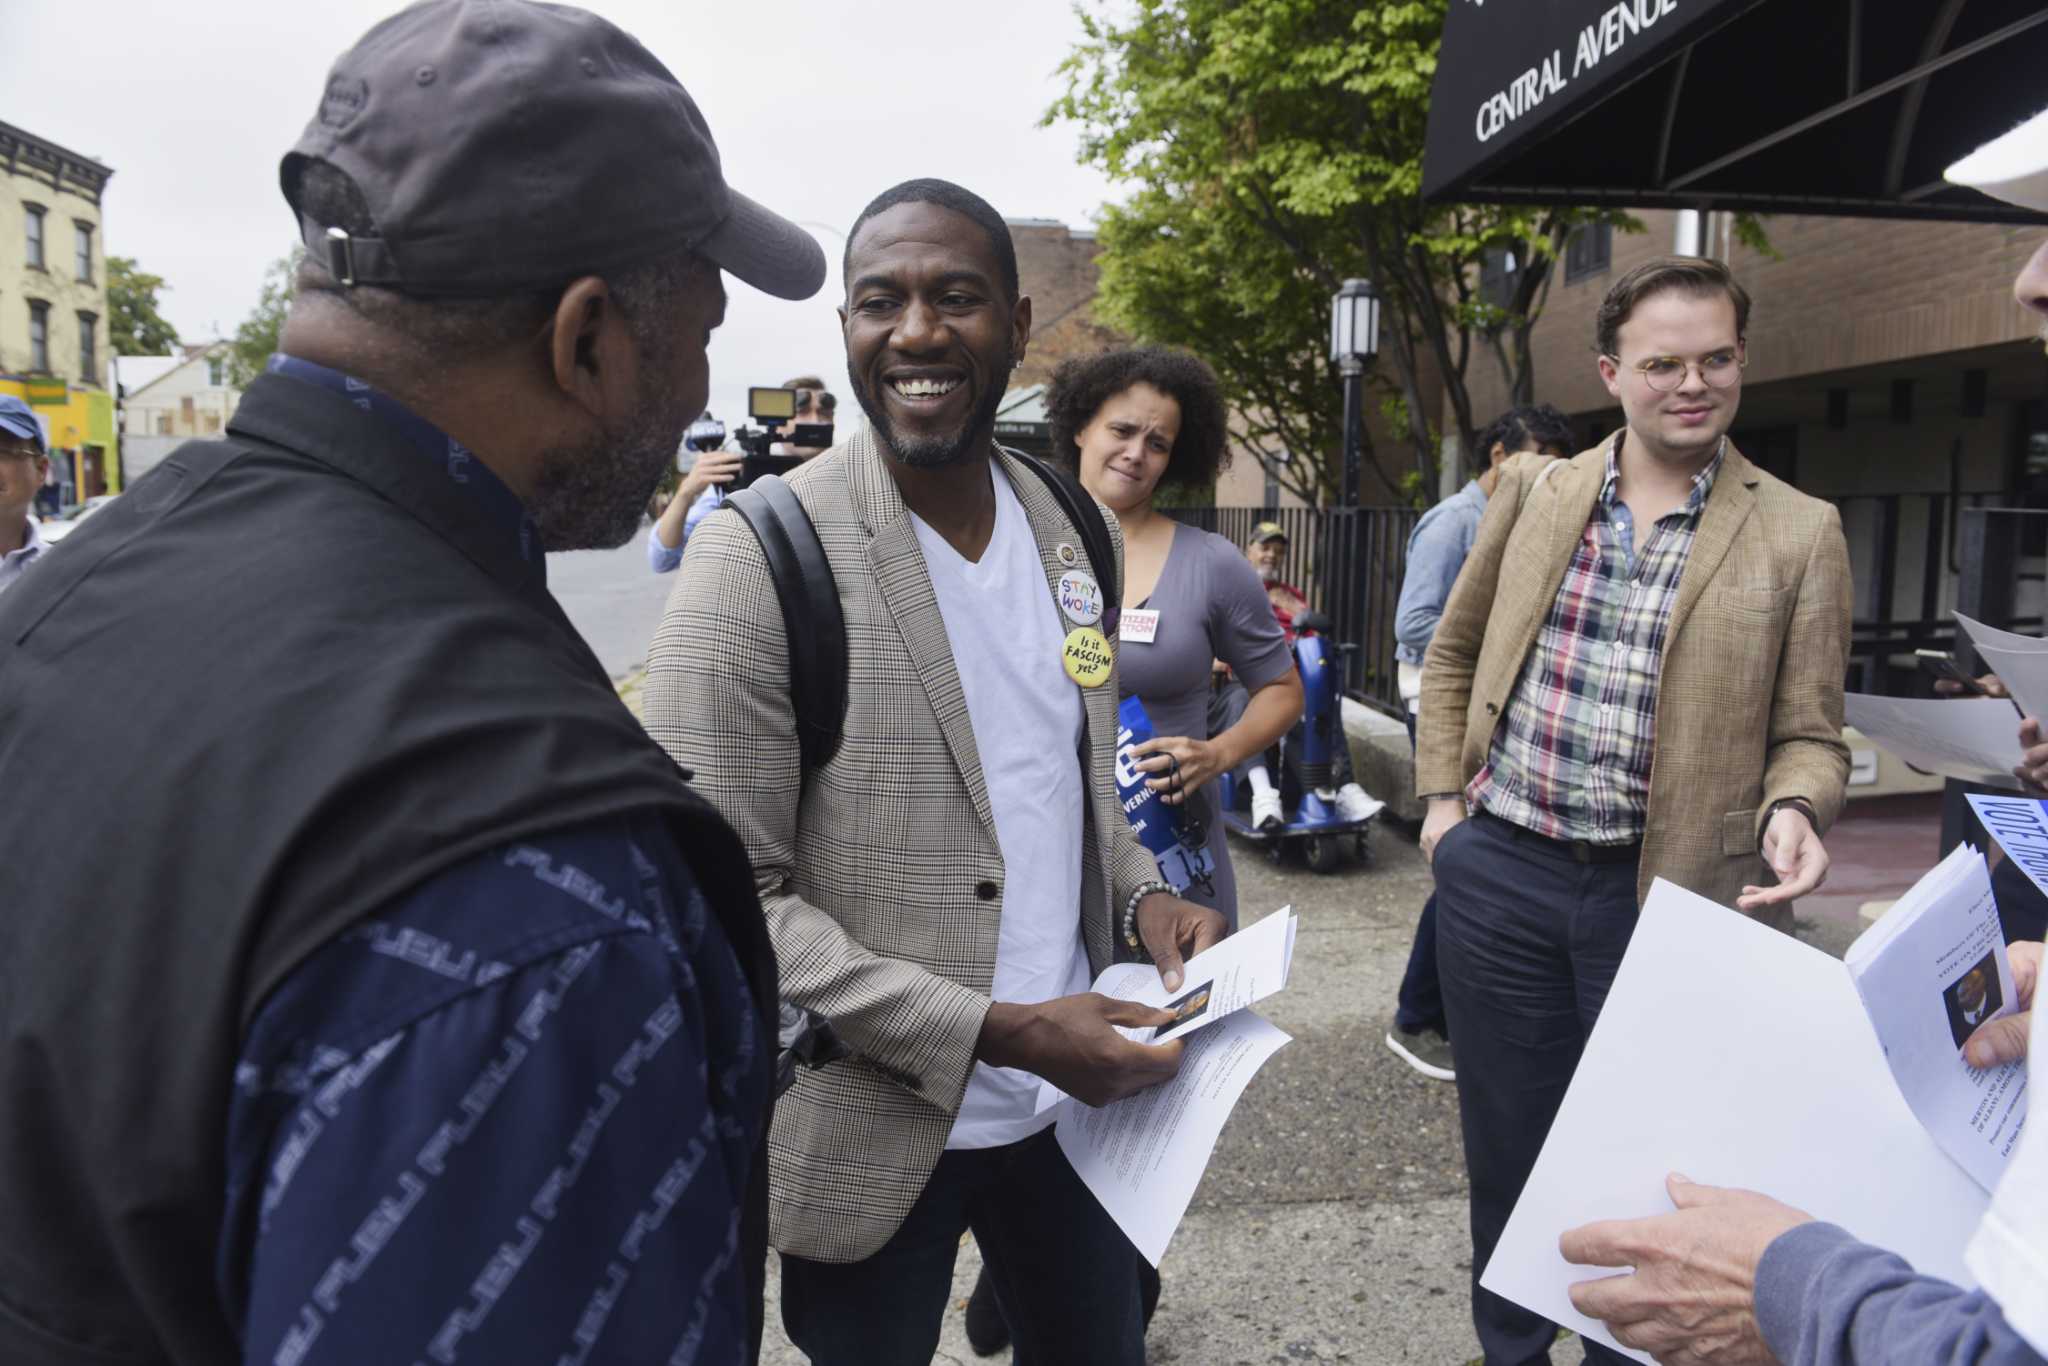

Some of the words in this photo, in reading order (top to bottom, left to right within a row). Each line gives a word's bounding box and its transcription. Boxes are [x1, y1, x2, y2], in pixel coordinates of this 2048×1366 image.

[1476, 49, 1568, 142] CENTRAL
[1062, 579, 1097, 598] STAY
[1062, 594, 1099, 615] WOKE
[1080, 635, 1088, 646] Is
[1092, 639, 1100, 650] it
[1066, 645, 1111, 667] FASCISM
[1075, 662, 1099, 674] yet?
